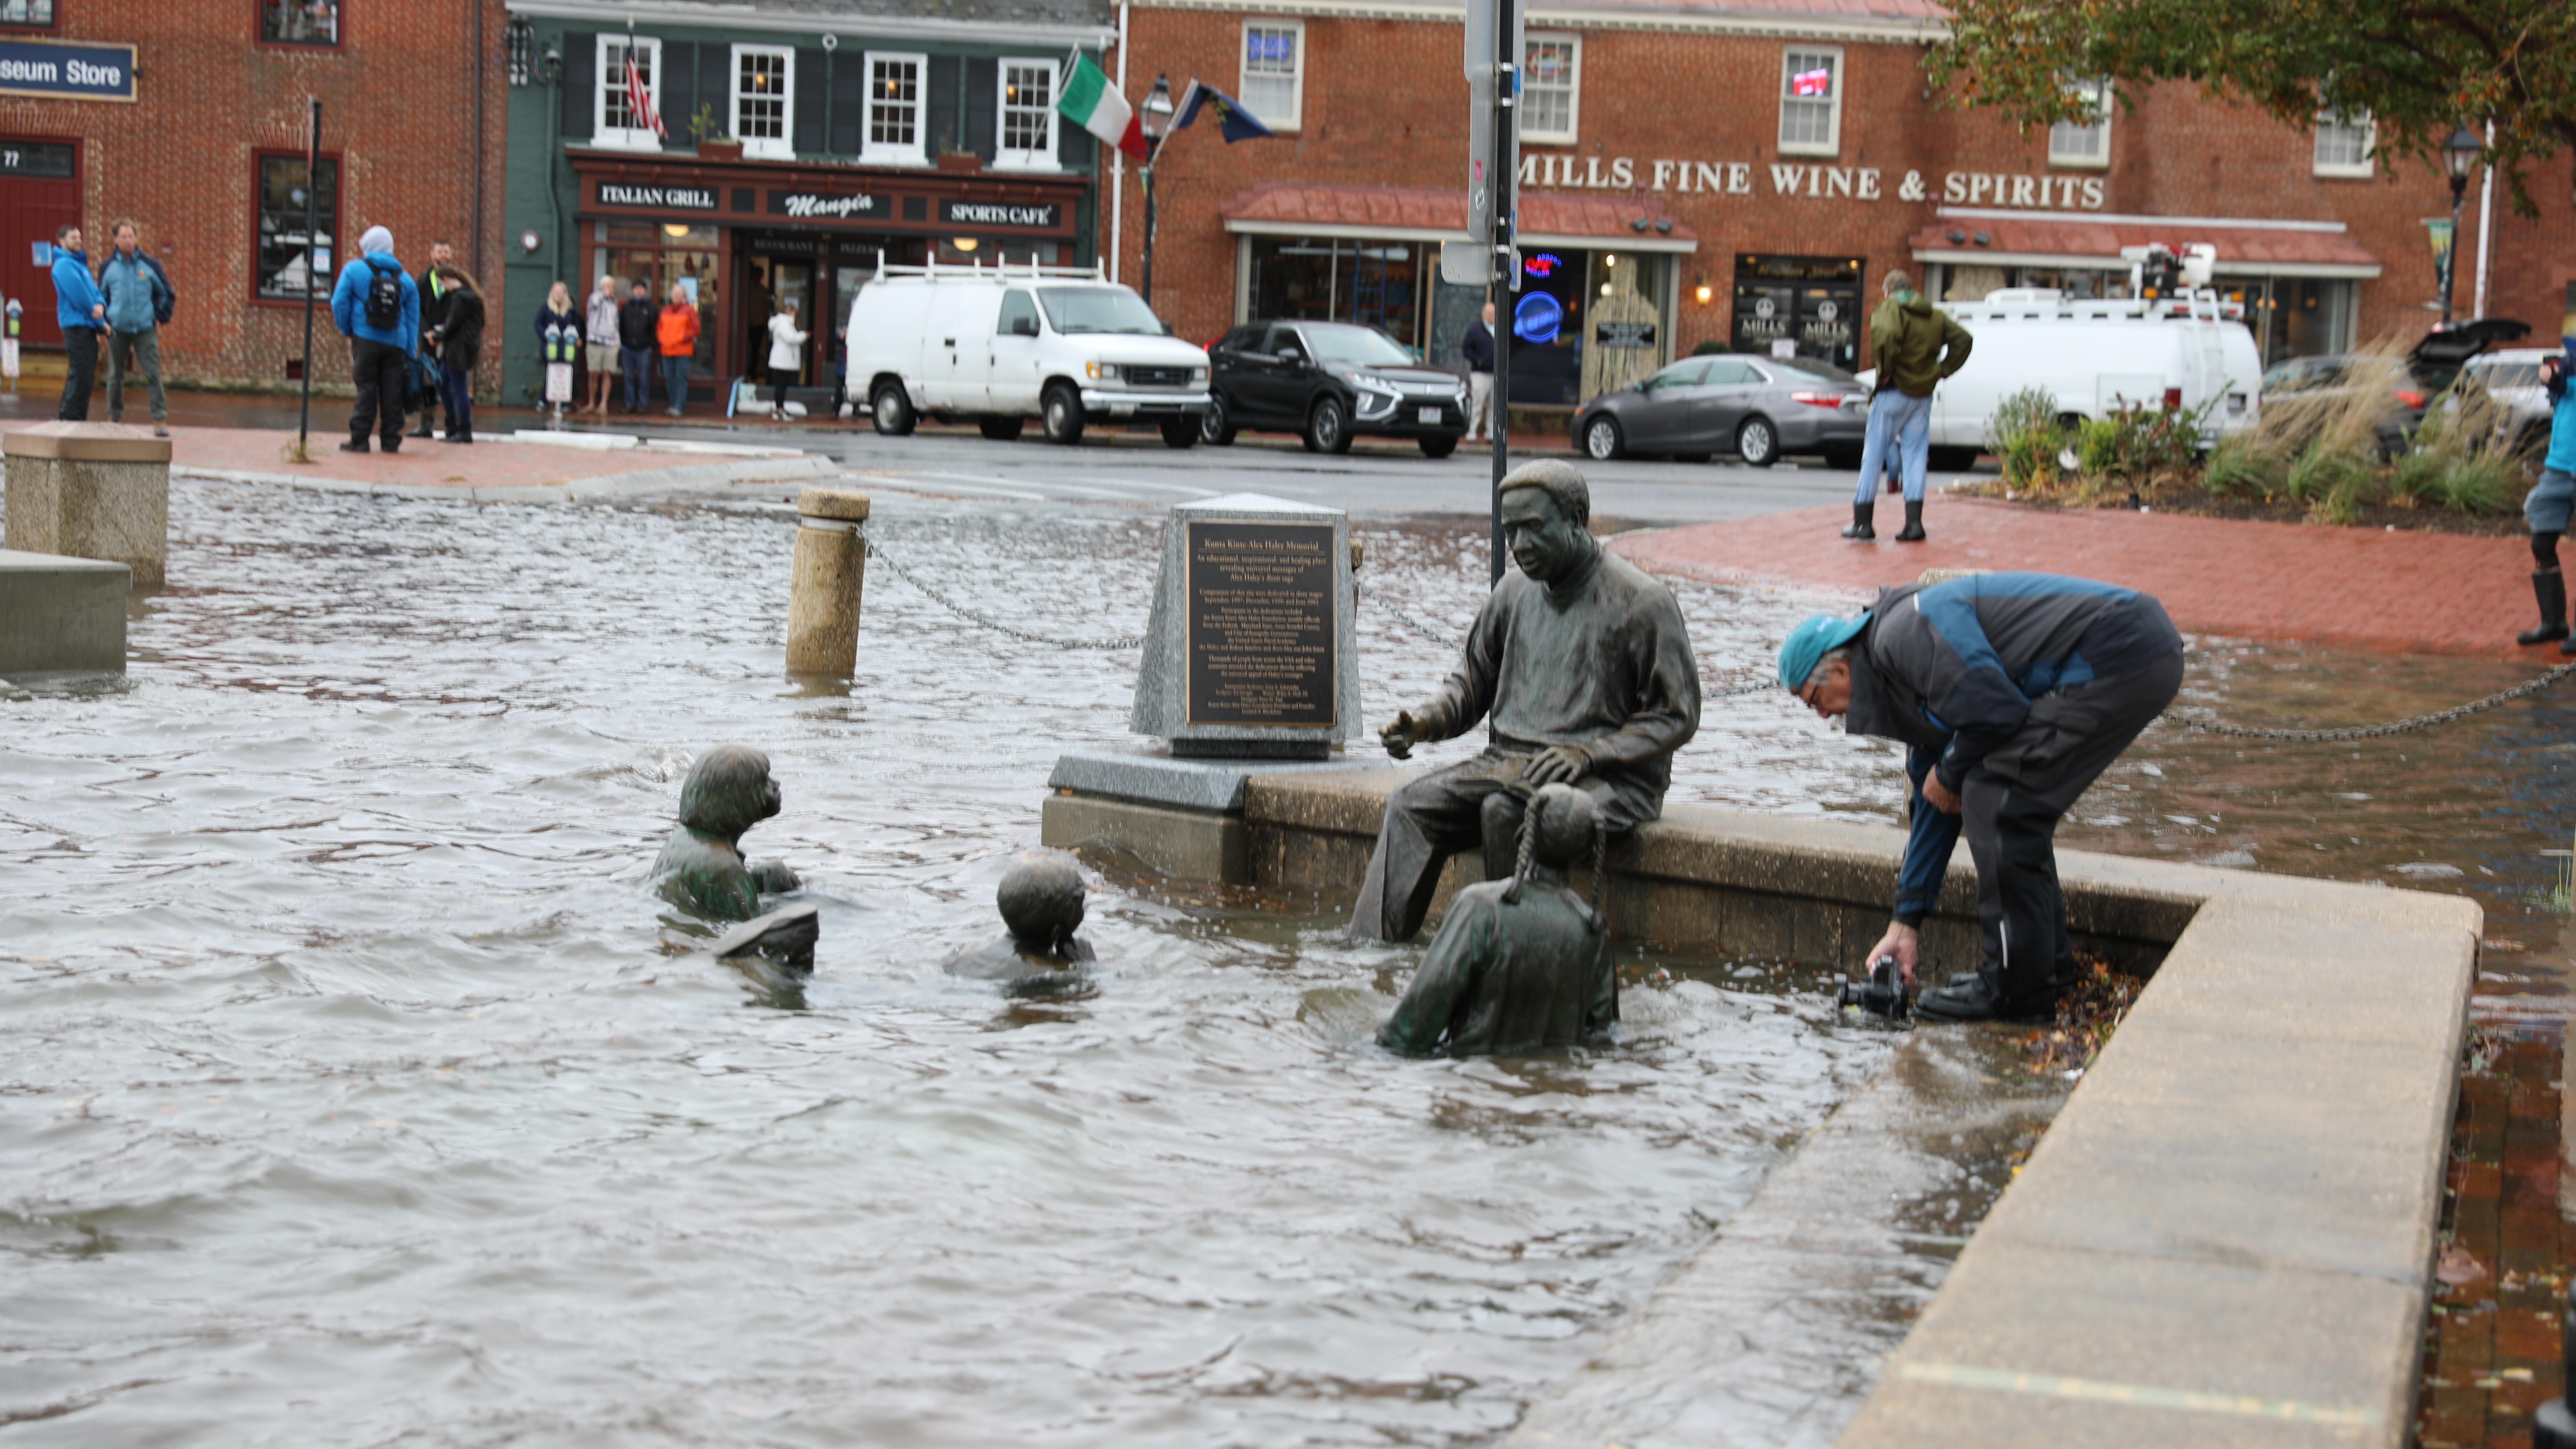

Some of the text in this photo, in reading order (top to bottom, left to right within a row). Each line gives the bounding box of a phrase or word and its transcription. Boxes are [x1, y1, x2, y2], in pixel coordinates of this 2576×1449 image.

[66, 58, 121, 87] Store
[3, 150, 20, 168] 77
[1518, 154, 1634, 189] MILLS
[1652, 159, 1751, 194] FINE
[1769, 163, 1881, 201] WINE
[1898, 169, 1926, 202] &
[1944, 171, 2105, 209] SPIRITS
[601, 185, 714, 209] ITALIAN GRILL
[785, 192, 874, 219] Mangia
[951, 202, 1008, 224] SPORTS
[1742, 319, 1786, 335] MILLS
[1804, 321, 1850, 338] MILLS
[1205, 538, 1226, 549] Kunta
[1265, 539, 1284, 553] Haley
[1286, 540, 1319, 551] Memorial
[1197, 554, 1205, 563] An
[1280, 556, 1290, 565] and
[1291, 556, 1311, 567] healing
[1312, 557, 1326, 567] place
[1230, 574, 1242, 582] Alex
